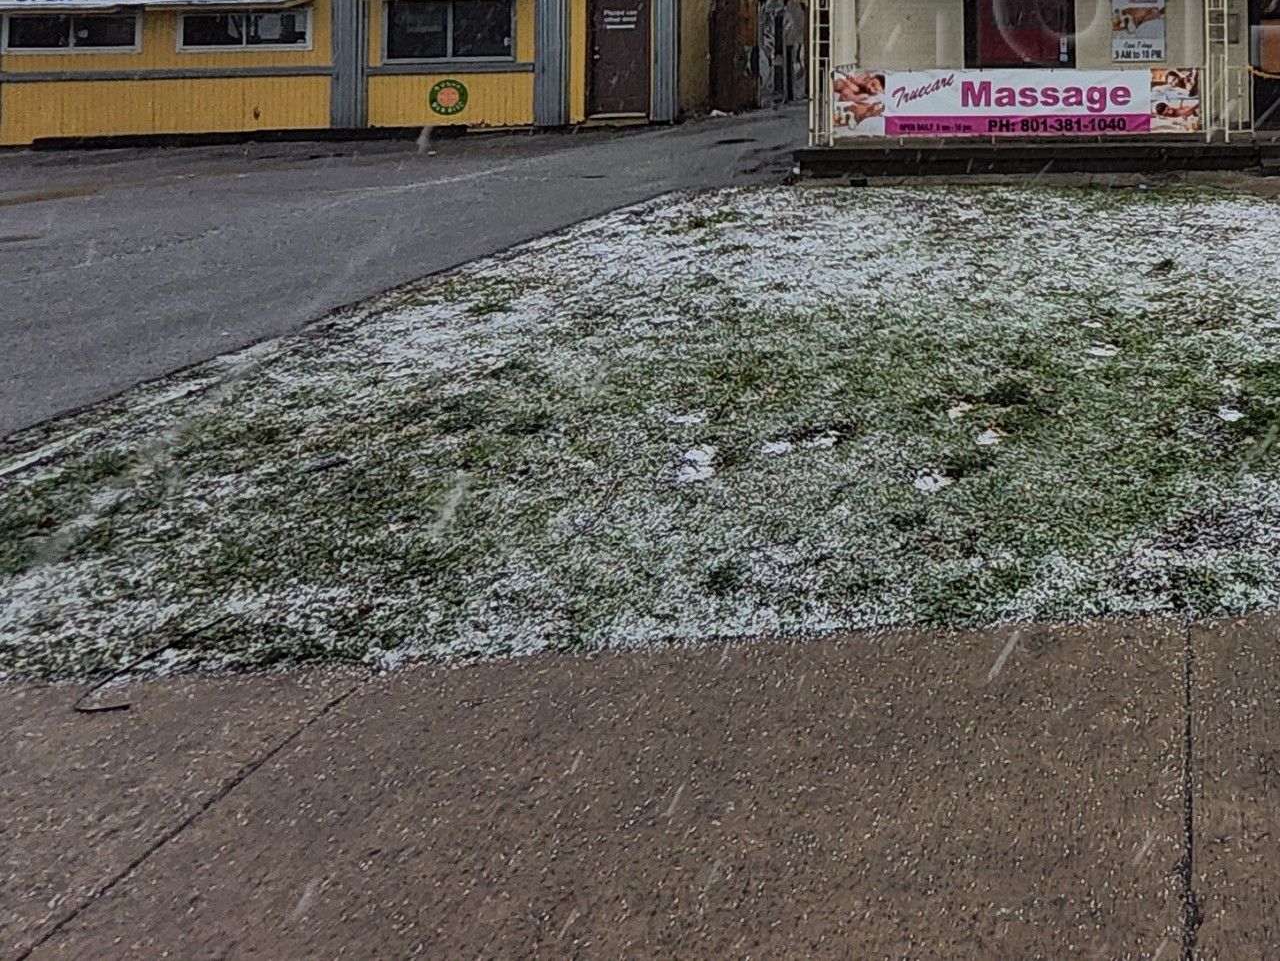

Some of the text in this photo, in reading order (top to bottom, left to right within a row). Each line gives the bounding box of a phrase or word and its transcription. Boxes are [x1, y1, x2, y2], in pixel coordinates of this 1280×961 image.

[891, 73, 1132, 113] Truecare Massage
[988, 119, 1015, 132] PH:
[1020, 118, 1127, 132] 801-381-1040
